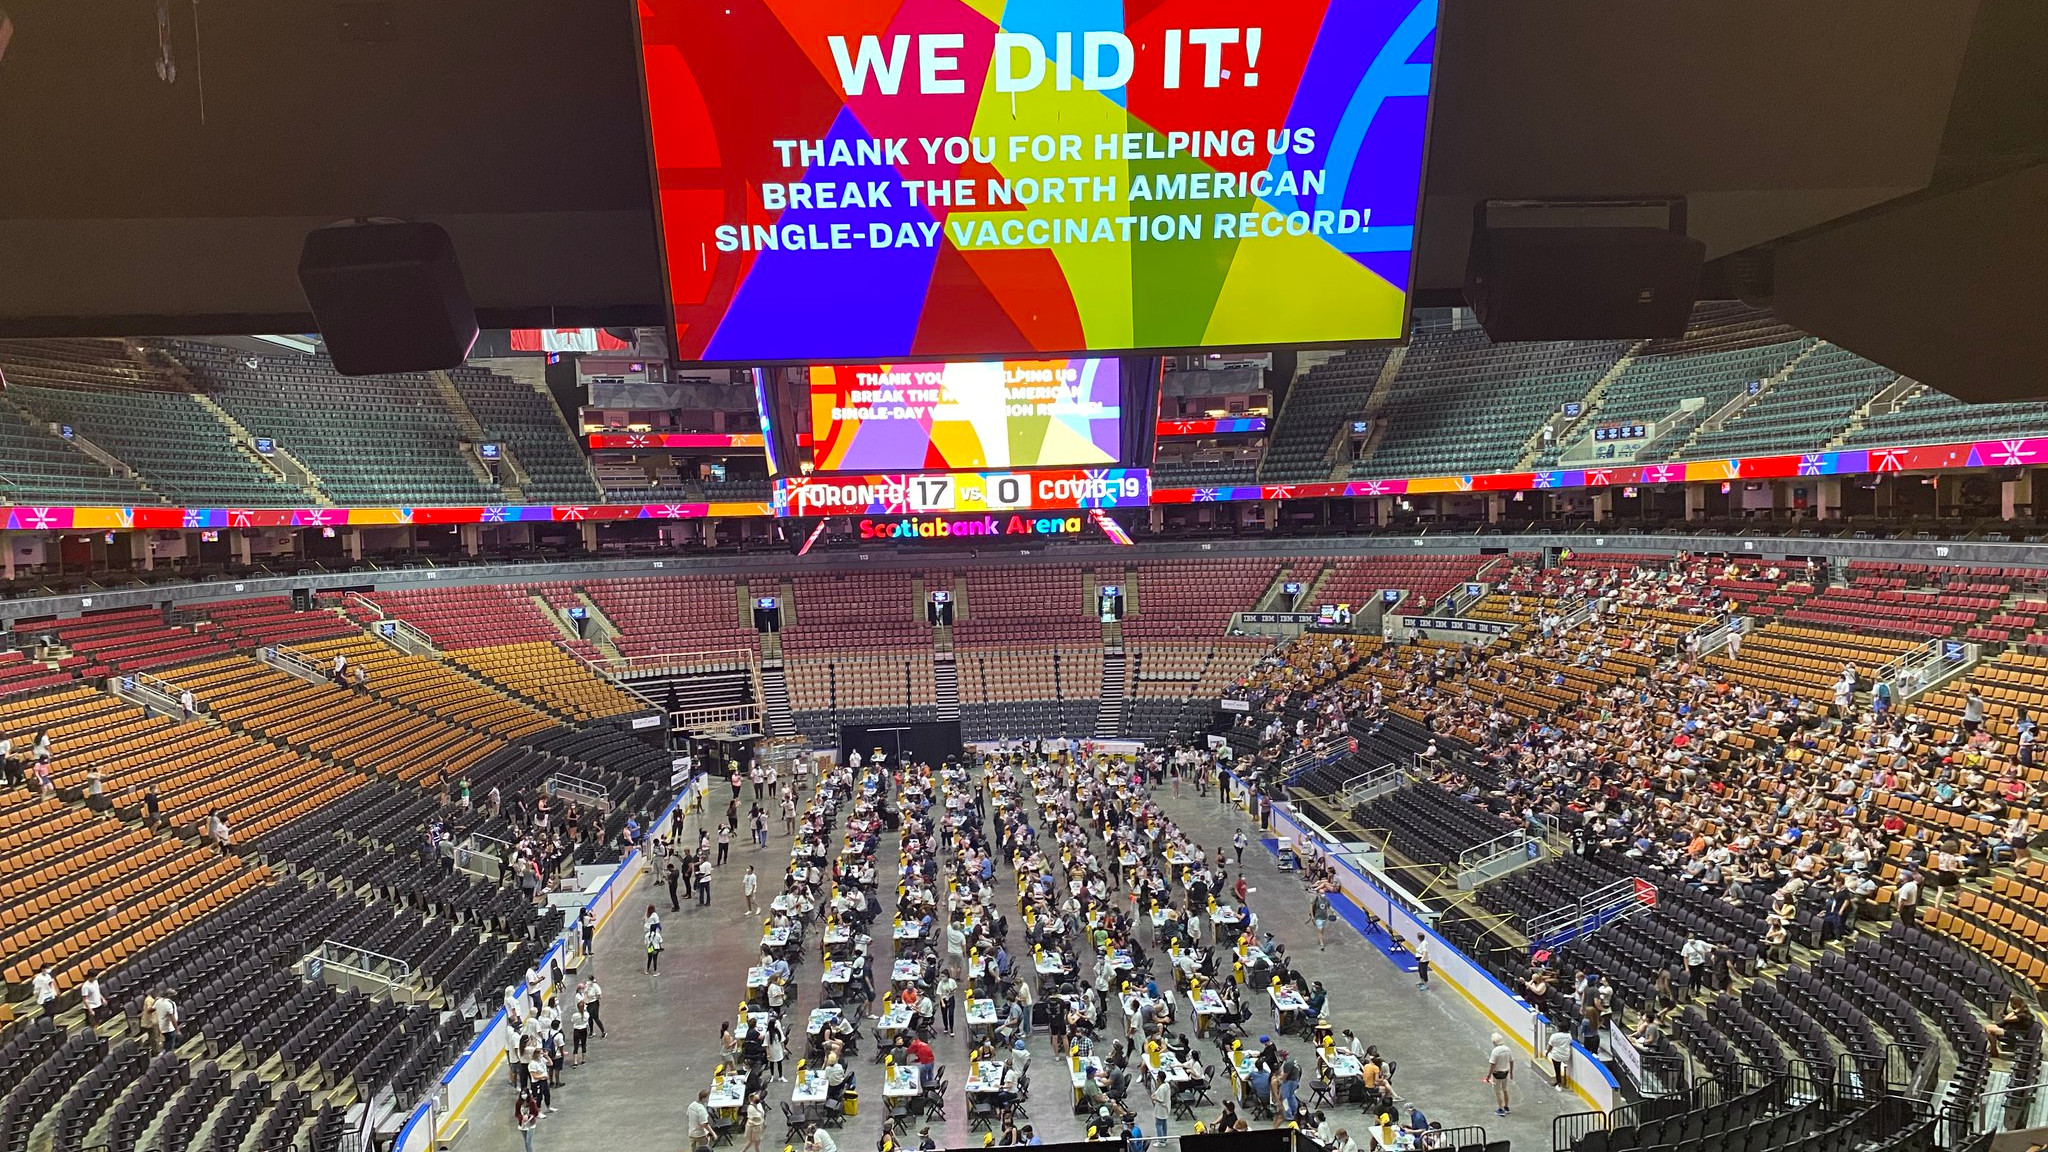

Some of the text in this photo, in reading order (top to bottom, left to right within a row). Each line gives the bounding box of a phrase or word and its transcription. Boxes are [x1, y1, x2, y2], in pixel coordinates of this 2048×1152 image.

[827, 27, 1262, 96] WE DID IT!
[773, 127, 1316, 168] THANK YOU FOR HELPING US
[761, 169, 1326, 210] BREAK THE NORTH AMERICAN
[715, 208, 1372, 252] SINGLE-DAY VACCINATION RECORD!
[856, 371, 911, 387] THANK
[914, 370, 947, 386] YOU
[1055, 367, 1078, 382] US
[851, 388, 905, 403] BREAK
[907, 388, 939, 403] THE
[831, 406, 928, 420] SINGLE-DAY
[798, 483, 905, 508] TORONTO
[917, 481, 948, 505] 17
[998, 478, 1020, 503] 0
[1039, 476, 1140, 500] COVID-19
[860, 514, 1082, 539] Scotiabank Arena
[1404, 618, 1416, 626] IBM
[1420, 619, 1431, 627] IBM
[1435, 620, 1447, 628] IBM
[1451, 621, 1463, 629] IBM
[1467, 622, 1477, 630] IBM
